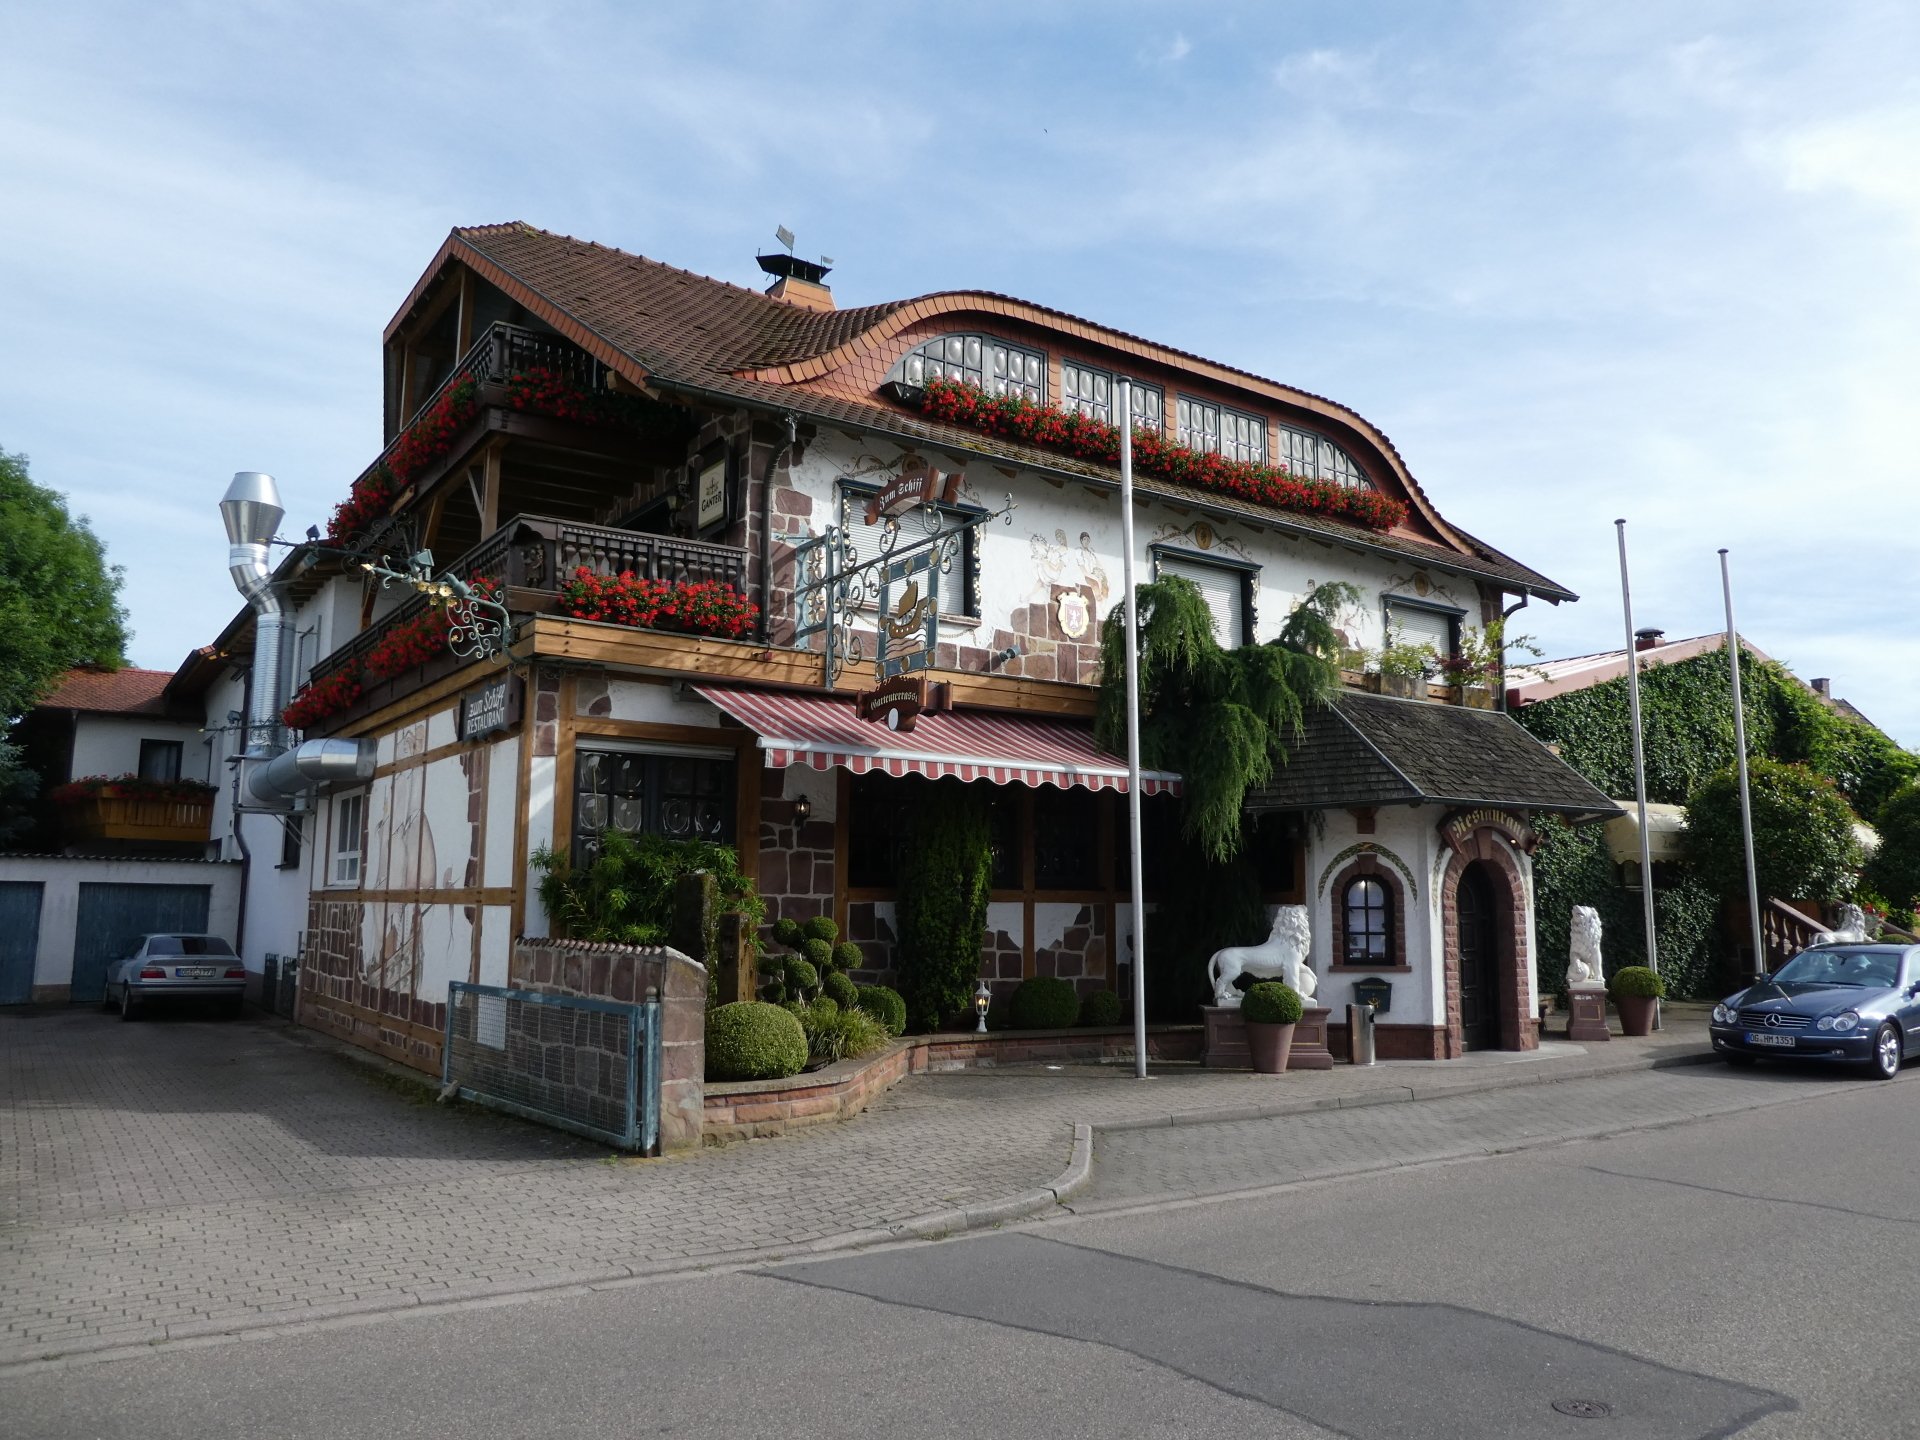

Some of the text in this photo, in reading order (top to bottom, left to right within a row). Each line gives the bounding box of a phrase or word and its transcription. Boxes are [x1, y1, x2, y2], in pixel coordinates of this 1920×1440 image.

[701, 490, 722, 512] GANTER
[879, 477, 923, 511] Zum Schiff
[484, 683, 506, 712] Schiff
[466, 706, 505, 735] RESTAURANT
[1452, 809, 1526, 840] Restaurant
